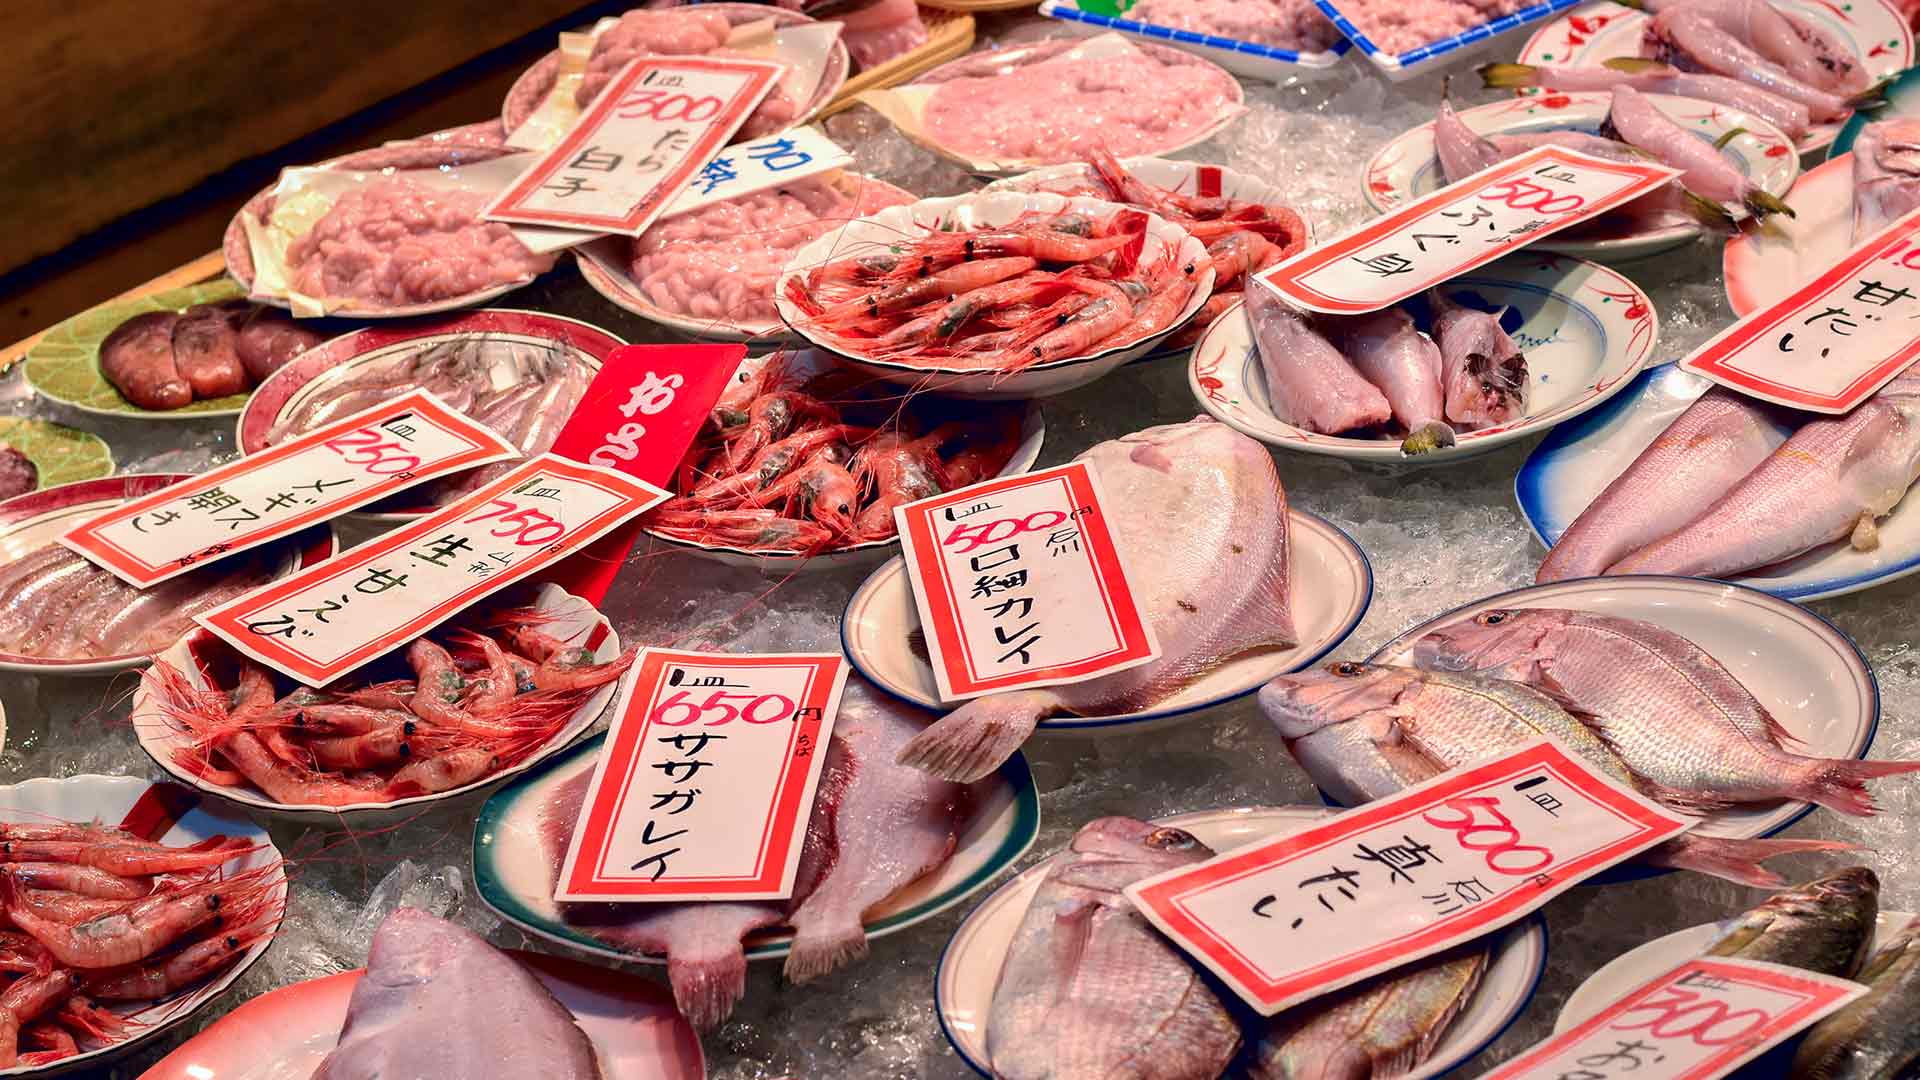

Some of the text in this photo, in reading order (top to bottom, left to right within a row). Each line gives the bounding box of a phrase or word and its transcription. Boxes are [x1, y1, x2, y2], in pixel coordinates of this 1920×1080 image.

[543, 146, 624, 198] 白子
[637, 128, 690, 173] たら
[1352, 205, 1495, 279] ふぐ身
[1778, 280, 1918, 359] 甘だい
[380, 413, 416, 443] 1皿
[132, 486, 243, 534] 開き
[220, 477, 356, 531] メギス
[944, 501, 1004, 521] 1皿
[1046, 527, 1080, 557] 石川
[970, 544, 1041, 665] 口細カレイ
[669, 668, 751, 688] 1皿
[631, 732, 728, 882] ササガレイ
[1513, 775, 1566, 818] 1皿
[1251, 834, 1444, 930] 真たい
[1422, 875, 1494, 917] 石川
